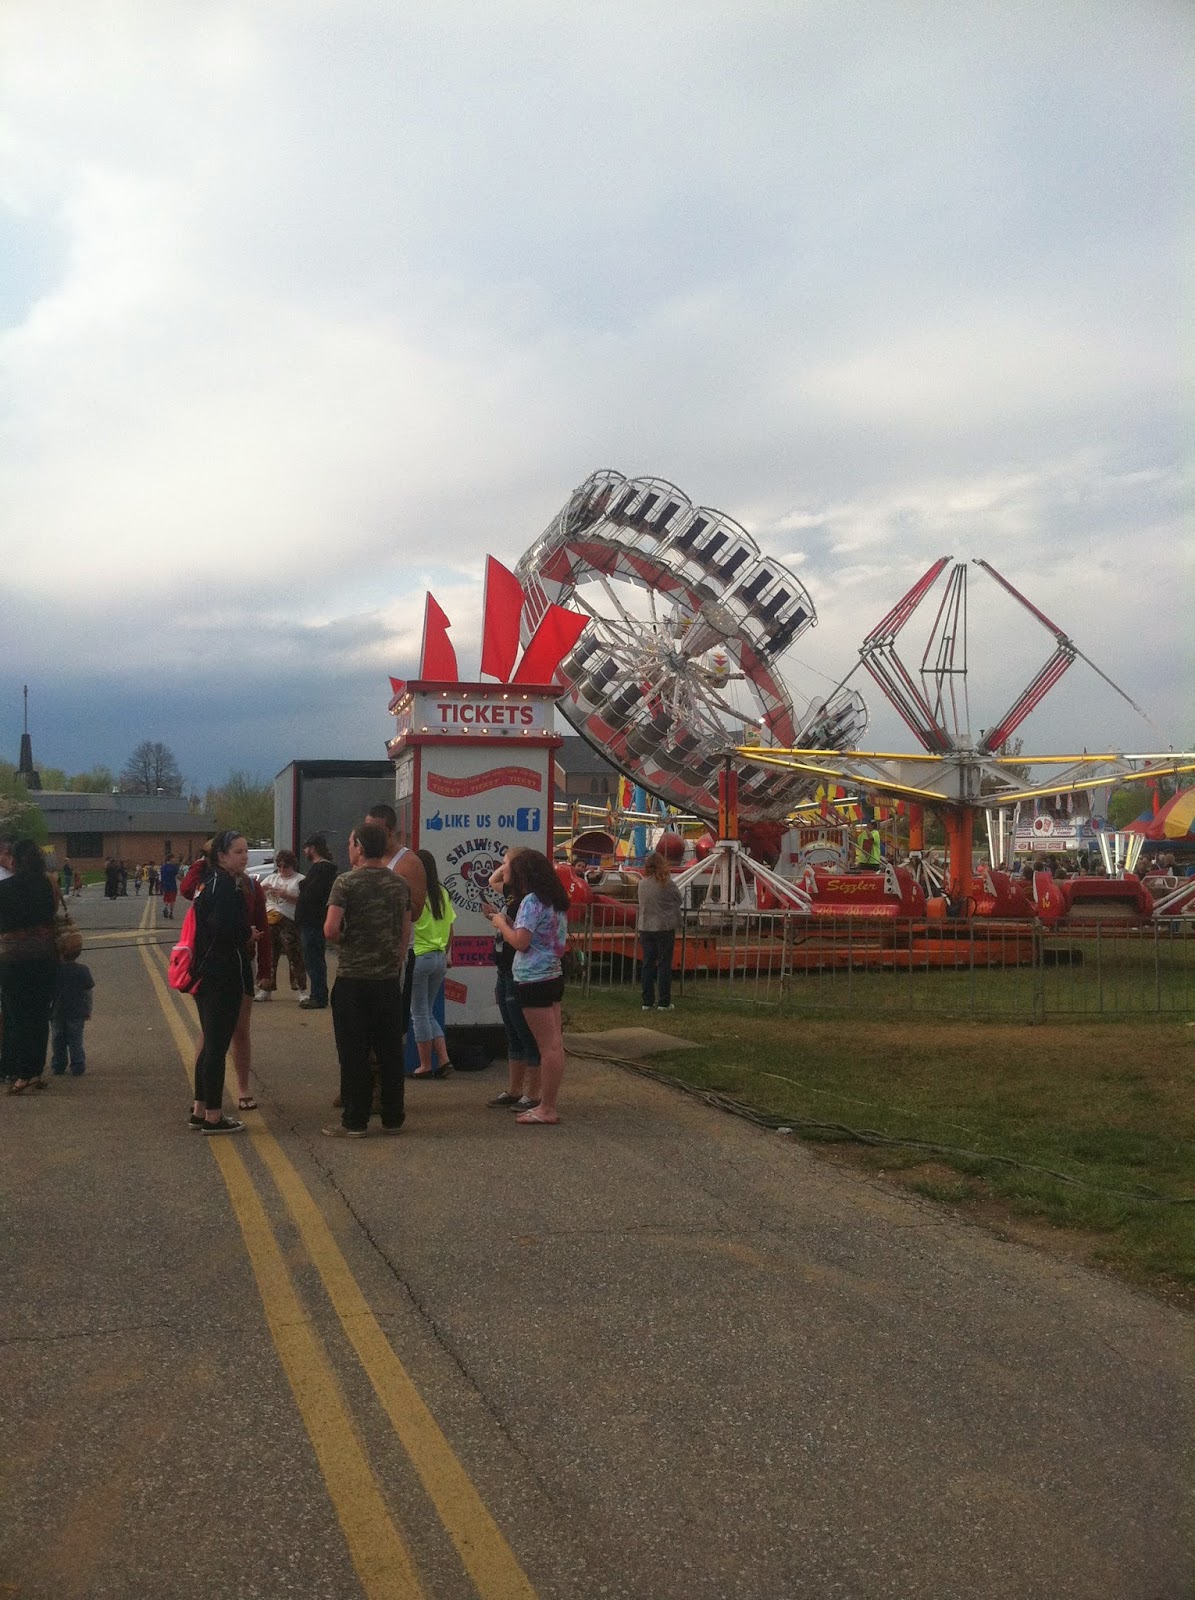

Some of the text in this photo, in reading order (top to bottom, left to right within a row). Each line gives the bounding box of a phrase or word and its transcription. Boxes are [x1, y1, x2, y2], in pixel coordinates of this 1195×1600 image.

[437, 704, 534, 725] TICKETS
[432, 783, 462, 795] TICKET
[471, 778, 499, 792] TICKET
[509, 776, 536, 787] TICKET
[444, 814, 470, 828] LIKE
[476, 815, 491, 828] US
[497, 815, 515, 828] ON
[446, 838, 488, 865] SHAW
[494, 840, 509, 858] SO
[569, 882, 576, 893] 5
[826, 879, 877, 895] Sizzler
[459, 953, 496, 962] TICK
